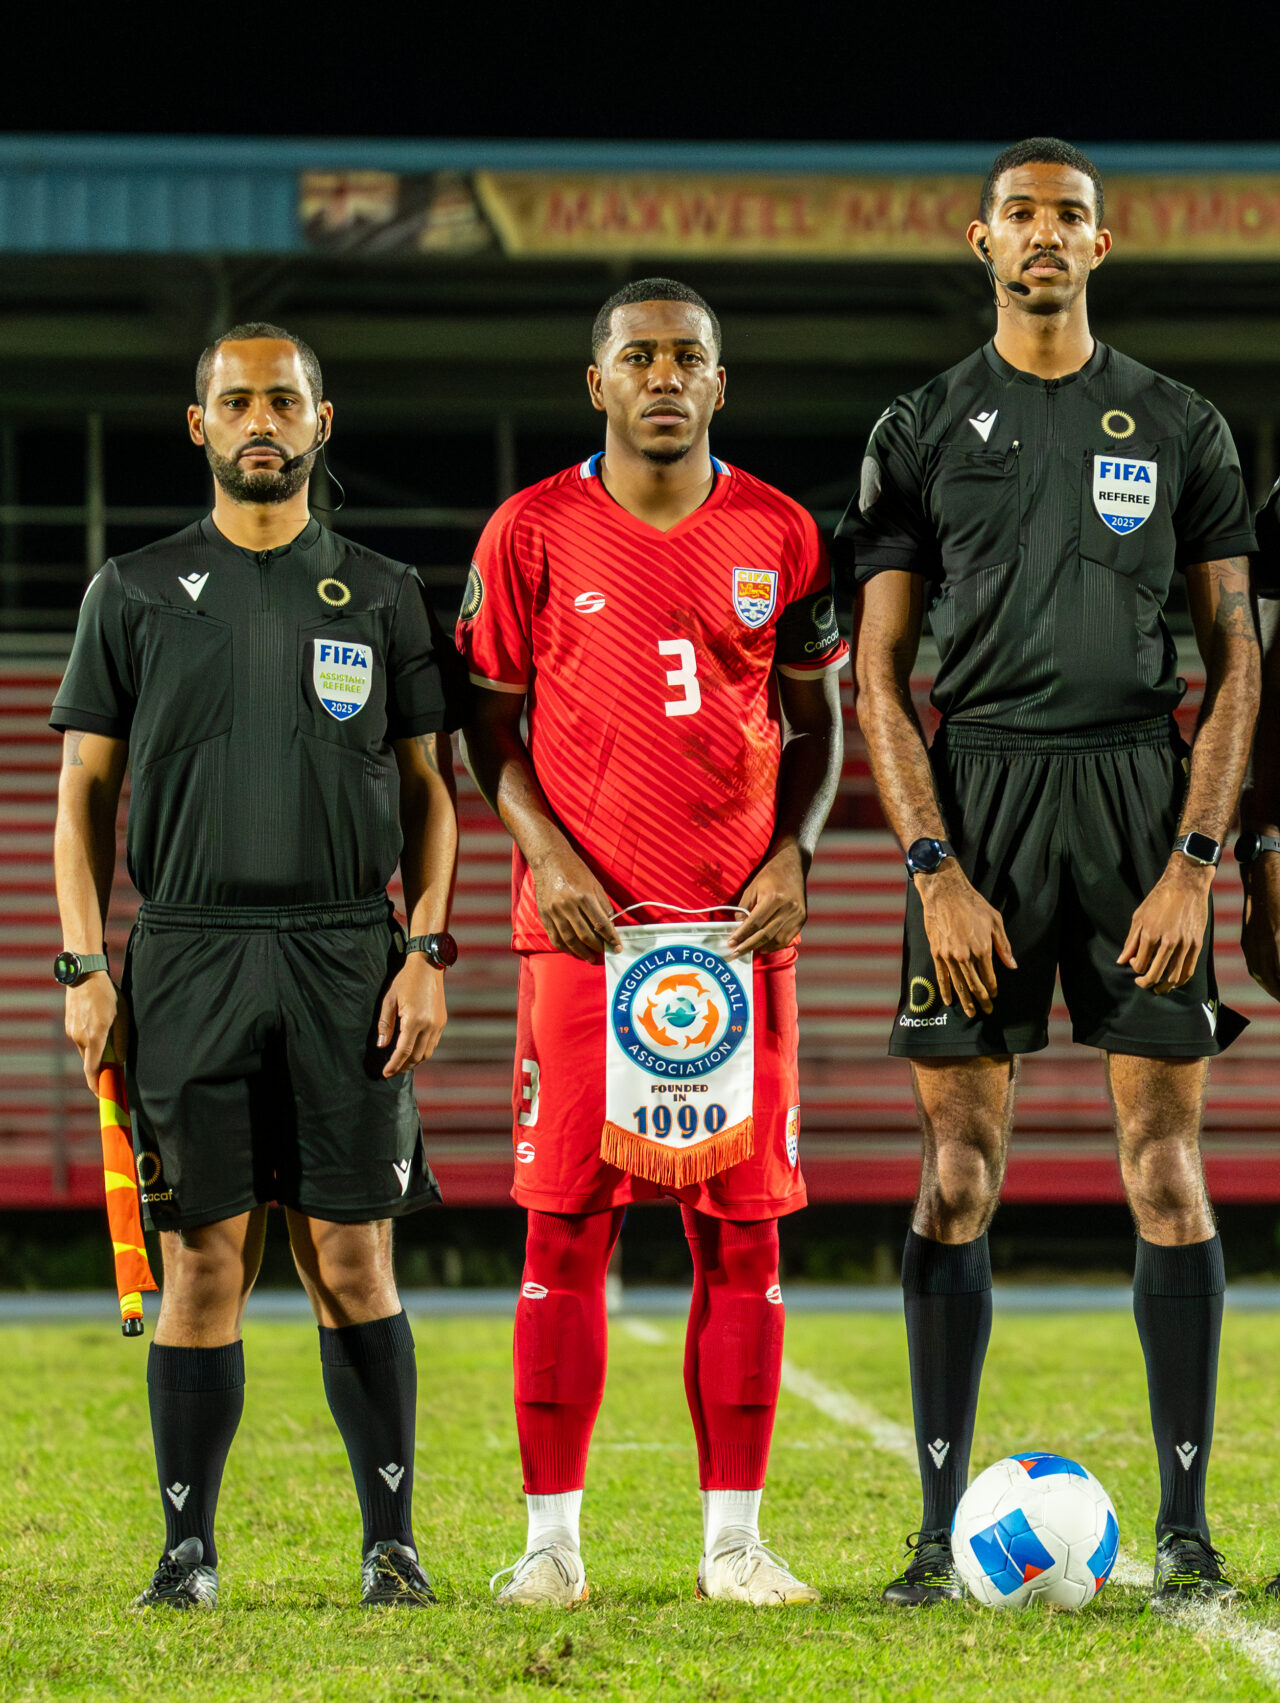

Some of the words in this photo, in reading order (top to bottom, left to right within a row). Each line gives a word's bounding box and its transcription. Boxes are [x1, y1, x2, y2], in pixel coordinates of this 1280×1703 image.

[545, 189, 818, 239] MAXWELL
[1100, 461, 1151, 484] FIFA
[1098, 491, 1150, 505] REFEREE
[1111, 516, 1135, 528] 2025
[738, 571, 772, 583] CIFA
[320, 644, 368, 669] FIFA
[320, 671, 366, 685] ASSISTANT
[658, 638, 702, 717] 3
[322, 680, 362, 694] REFEREE
[331, 702, 353, 714] 2025
[617, 951, 676, 1012] ANGUILLA
[682, 949, 744, 1012] FOOTBALL
[619, 1026, 630, 1034] 19
[731, 1024, 743, 1033] 90
[628, 1041, 732, 1075] ASSOCIATION
[518, 1058, 540, 1127] 3
[651, 1084, 709, 1093] FOUNDED
[673, 1094, 687, 1102] IN
[632, 1103, 728, 1140] 1990
[142, 1188, 173, 1203] cacaf
